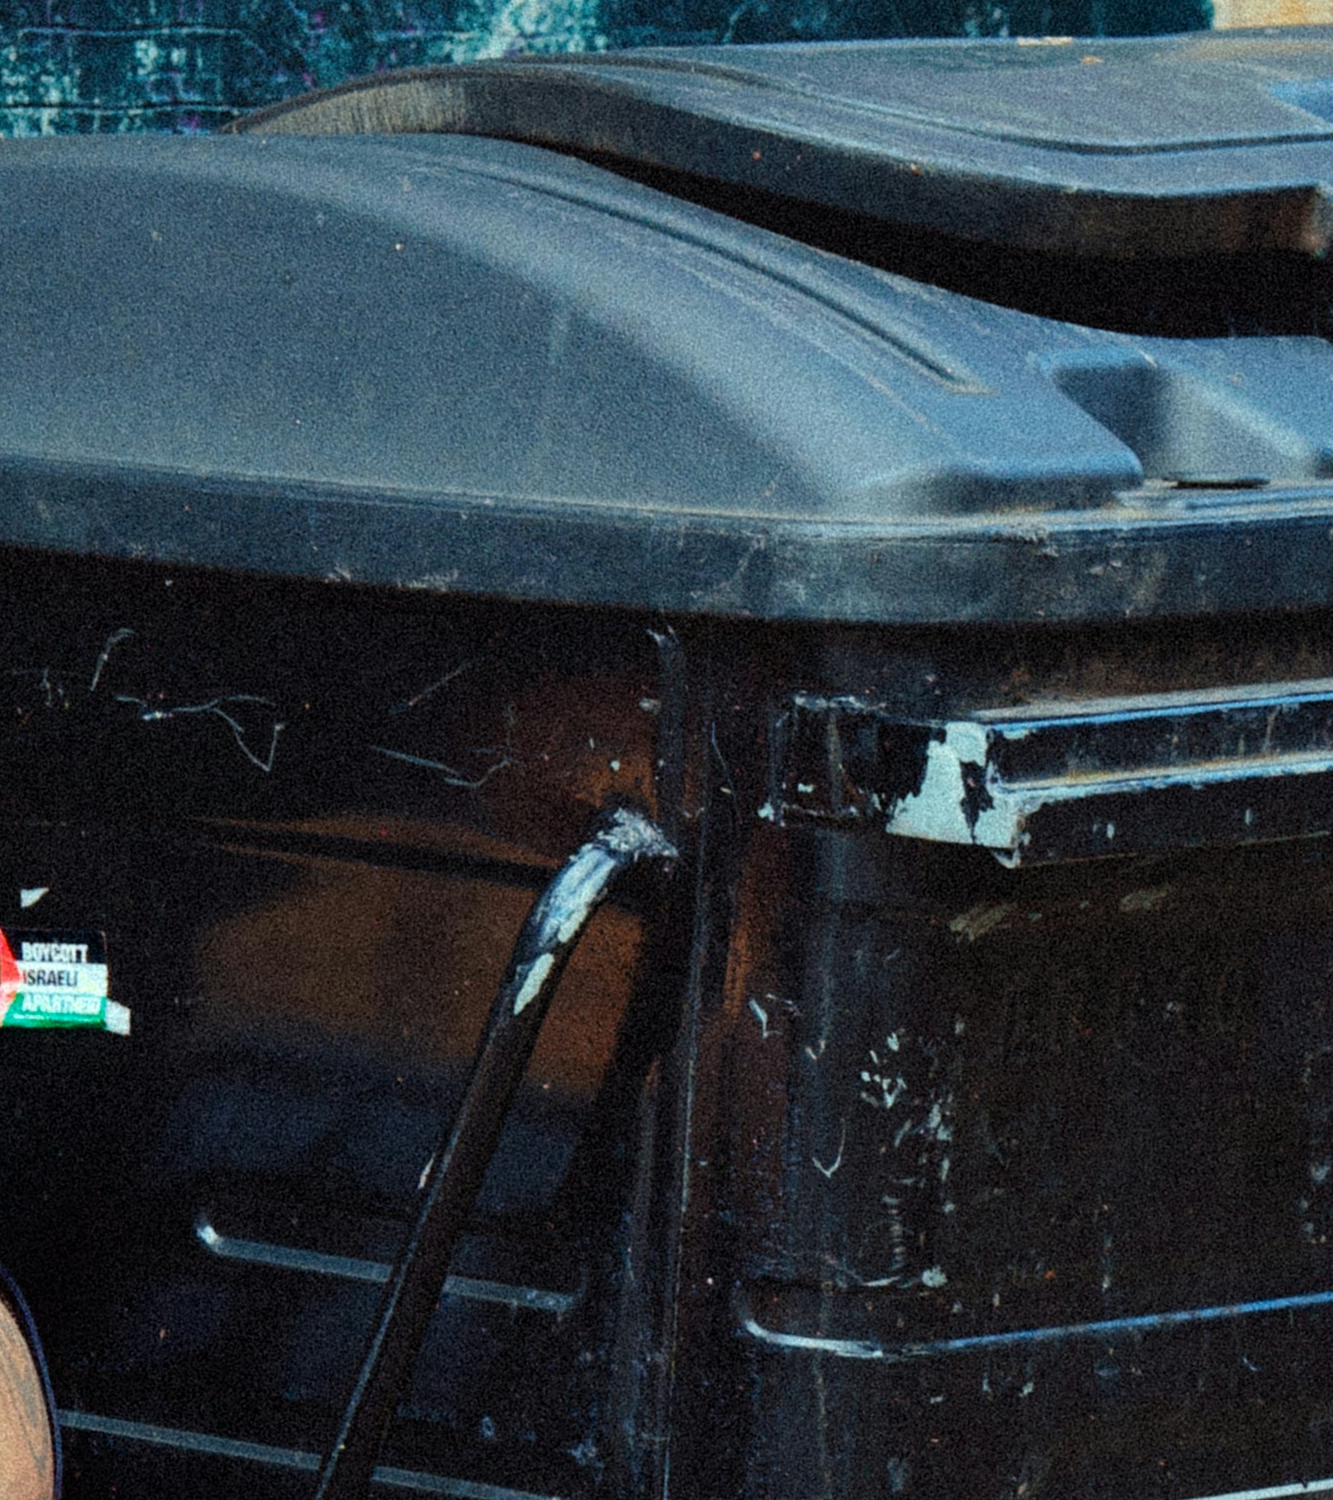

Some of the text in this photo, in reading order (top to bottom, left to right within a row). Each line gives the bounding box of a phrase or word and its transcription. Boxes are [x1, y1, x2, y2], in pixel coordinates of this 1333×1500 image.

[21, 941, 88, 963] BOYCOTT
[22, 969, 78, 987] ISRAELI
[21, 993, 102, 1015] APARTHEID
